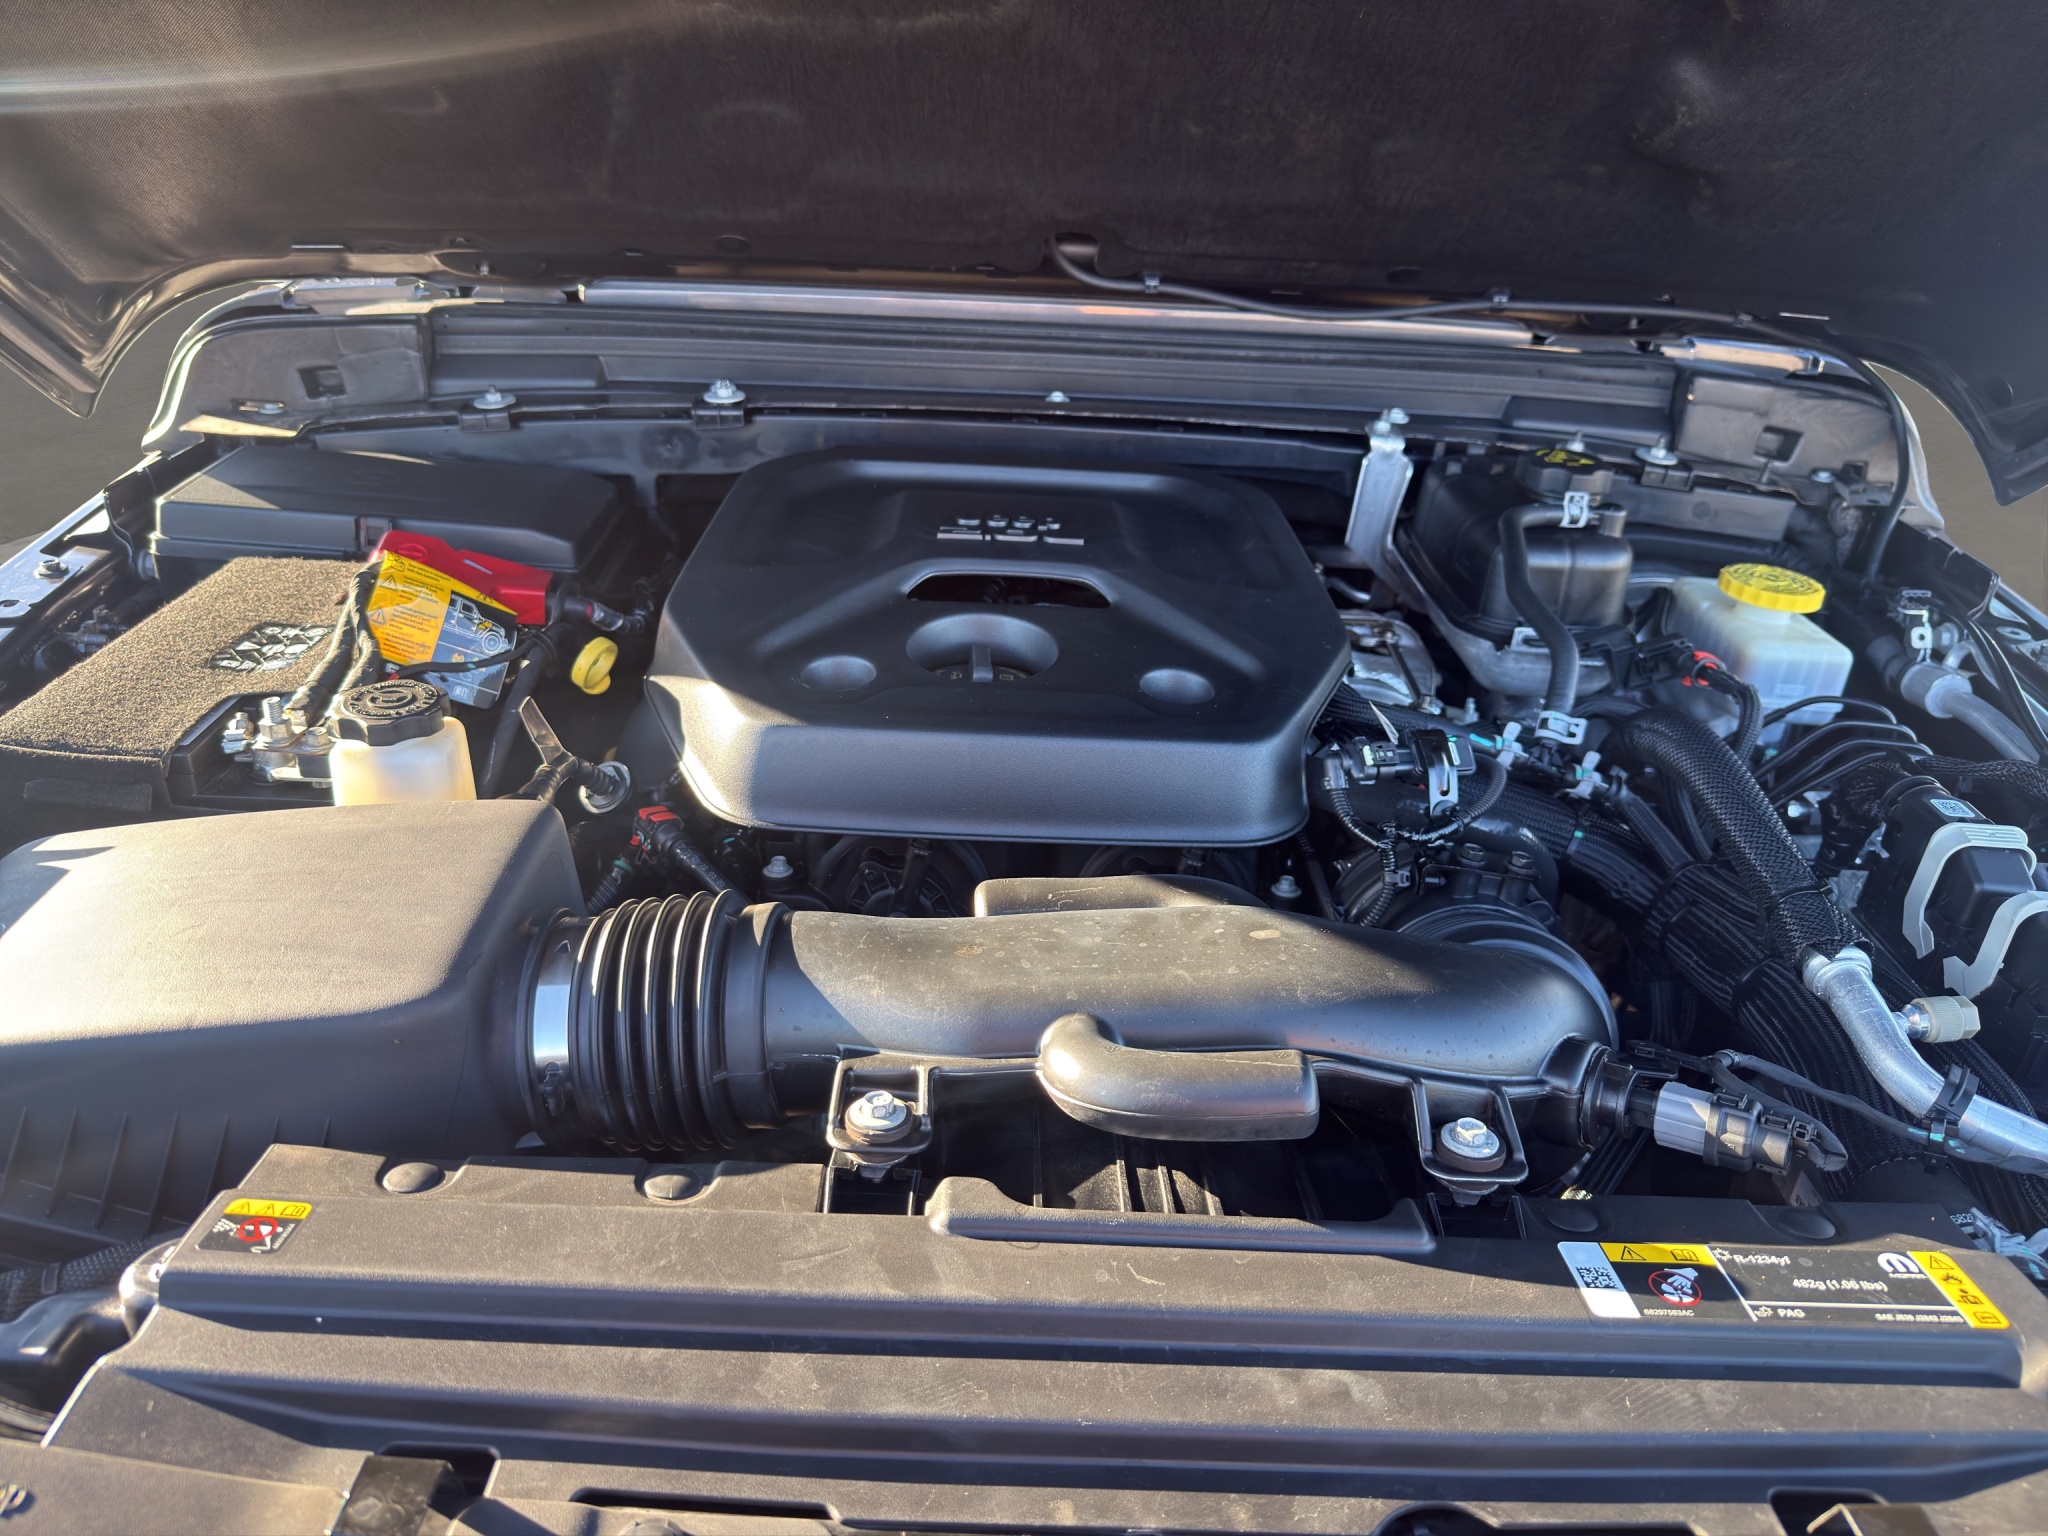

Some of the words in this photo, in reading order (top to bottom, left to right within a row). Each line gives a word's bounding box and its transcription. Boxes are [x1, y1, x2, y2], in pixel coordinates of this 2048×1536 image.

[1733, 1254, 1791, 1266] R-1234yf
[1793, 1278, 1826, 1290] 482g
[1826, 1280, 1860, 1291] (1.06
[1860, 1280, 1888, 1292] lbs)
[1777, 1308, 1806, 1318] PAG
